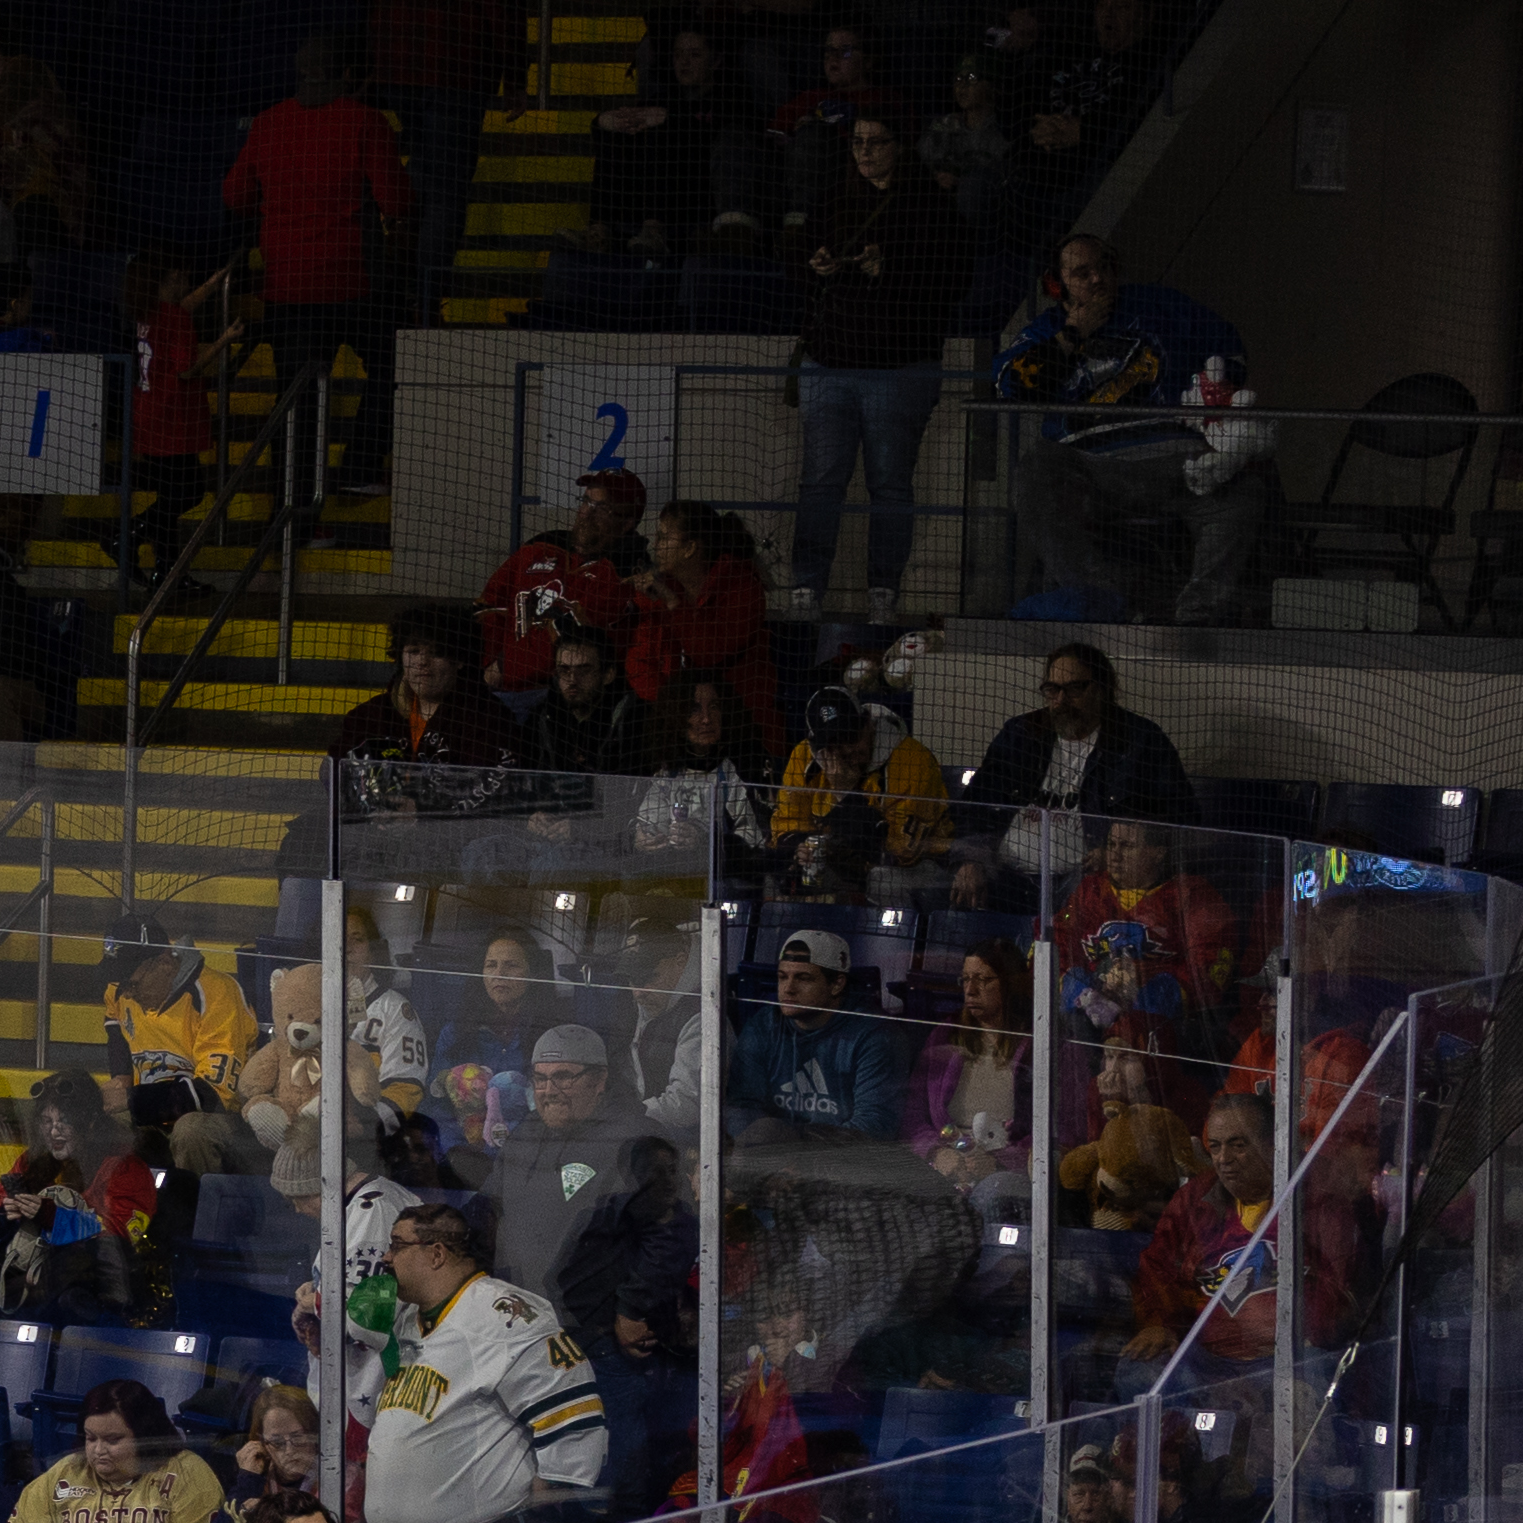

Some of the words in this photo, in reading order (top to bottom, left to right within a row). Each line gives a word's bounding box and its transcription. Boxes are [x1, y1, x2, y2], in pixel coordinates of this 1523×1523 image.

[29, 391, 51, 458] 1
[588, 402, 630, 471] 2
[364, 1017, 384, 1044] C
[401, 1036, 426, 1067] 59
[209, 1052, 242, 1091] 35
[774, 1090, 840, 1116] adidas
[547, 1331, 587, 1369] 40
[158, 1472, 177, 1499] A
